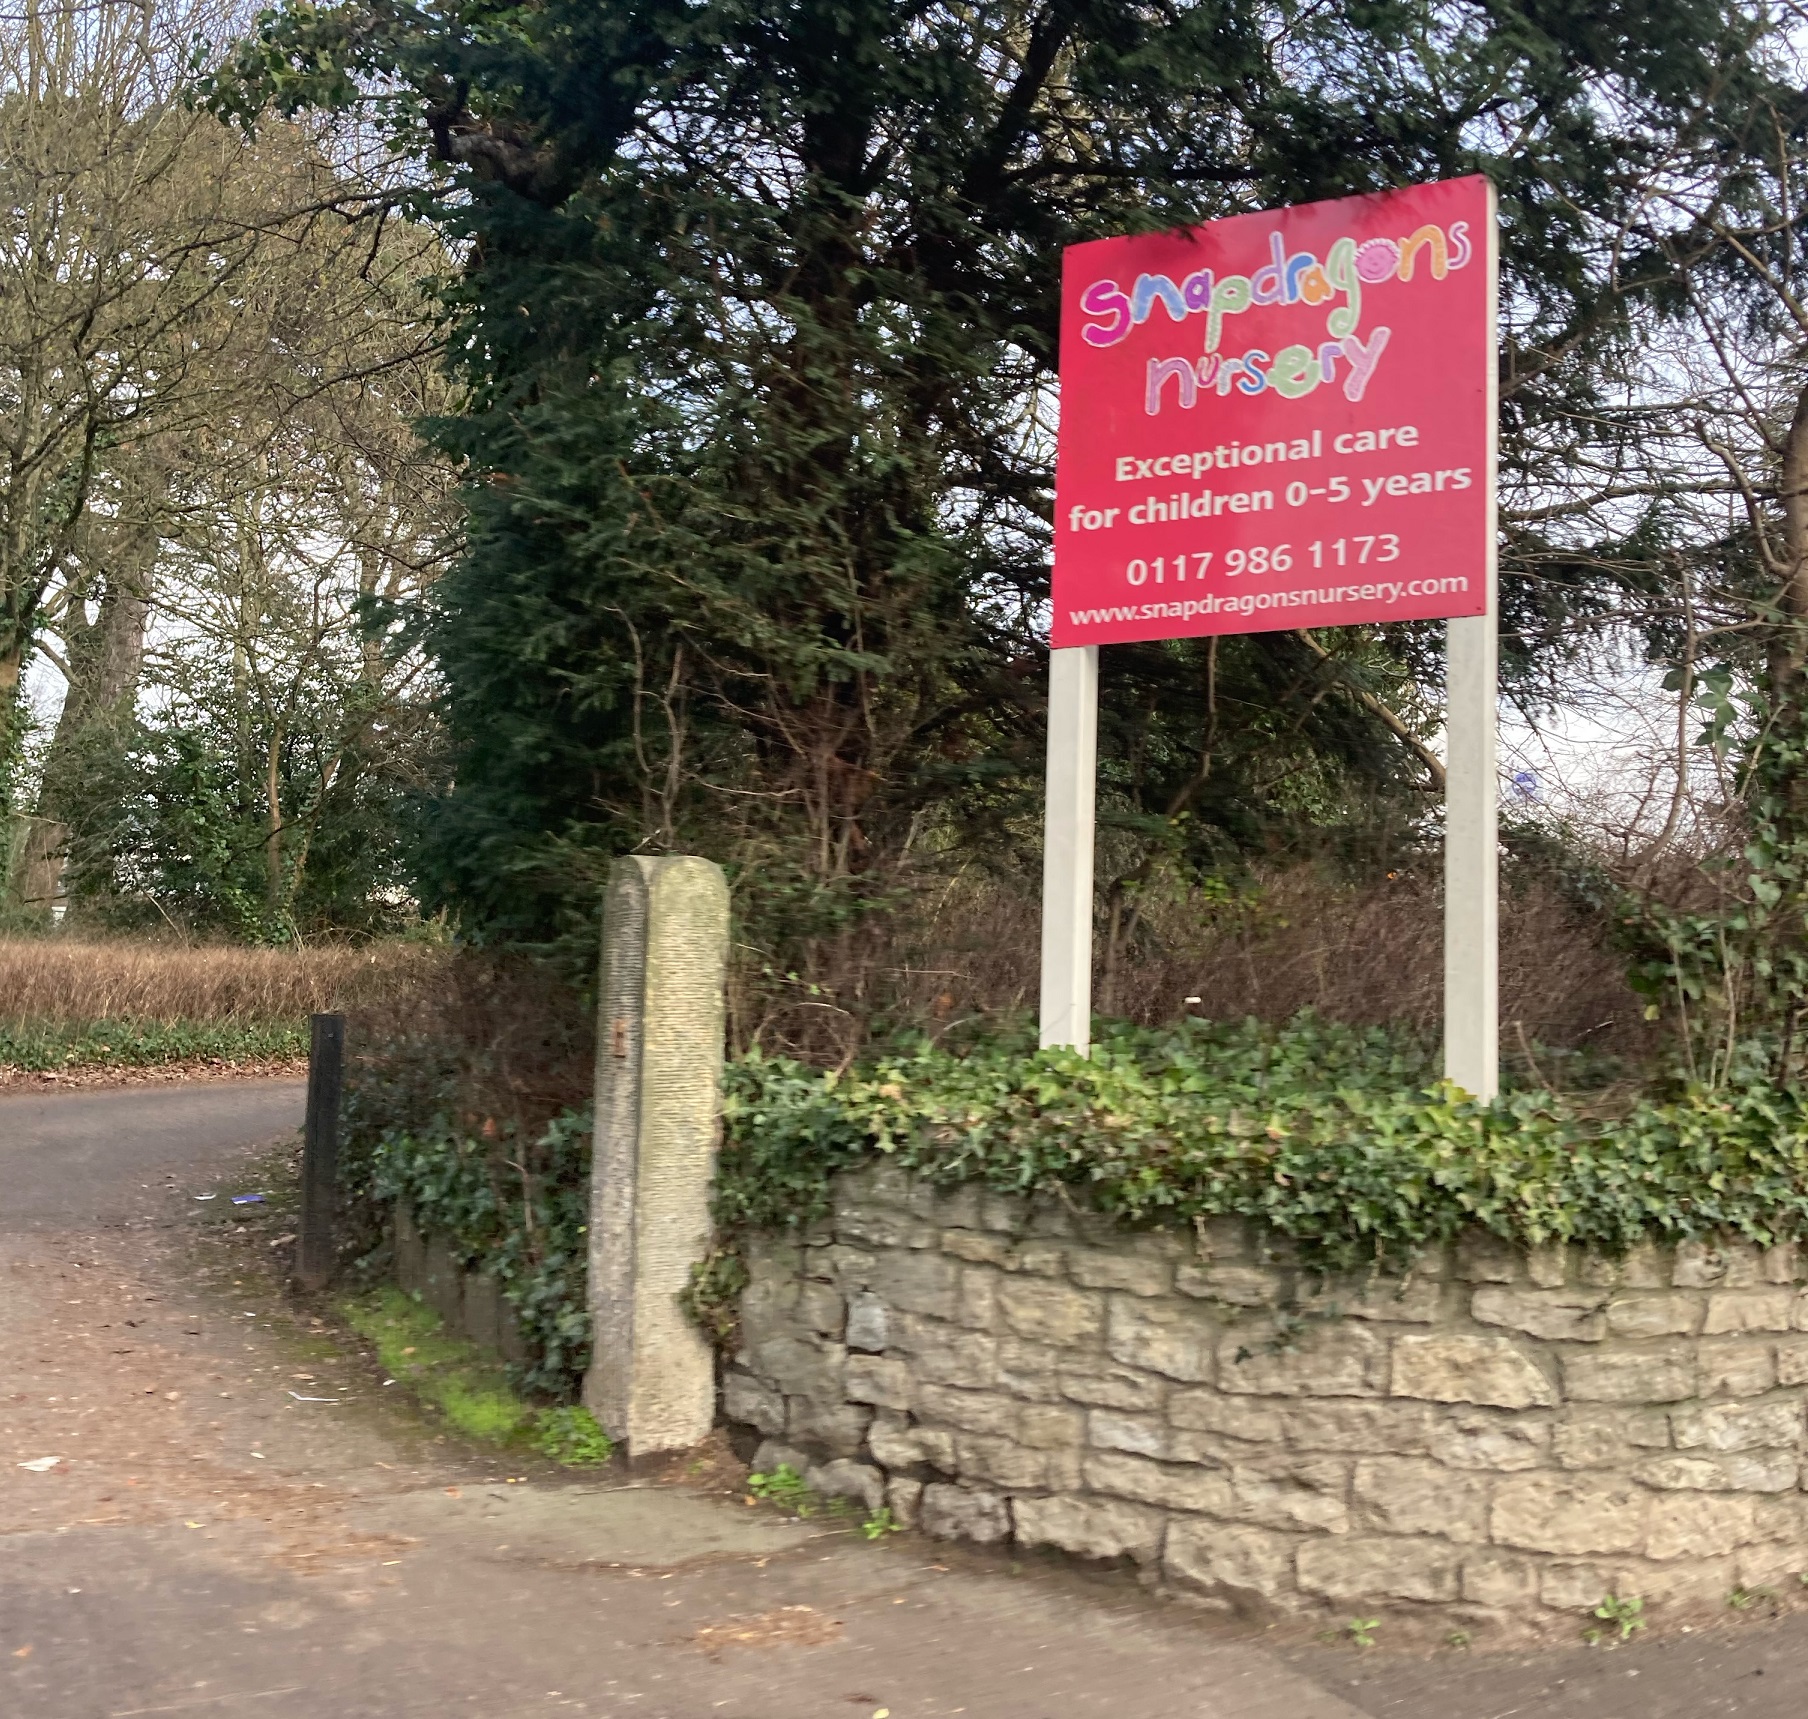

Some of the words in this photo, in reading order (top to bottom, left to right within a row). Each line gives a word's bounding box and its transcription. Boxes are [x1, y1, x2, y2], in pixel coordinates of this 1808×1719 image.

[1080, 221, 1471, 352] snapdragons
[1145, 326, 1391, 416] nursery
[1115, 430, 1321, 481] Exceptional
[1334, 425, 1419, 453] care
[1069, 504, 1120, 531] for
[1128, 488, 1273, 525] children
[1361, 466, 1472, 506] years
[1126, 552, 1214, 586] 0117
[1225, 544, 1293, 576] 986
[1308, 533, 1400, 568] 1173
[1070, 575, 1468, 625] www.snapdragonsnursery.com
